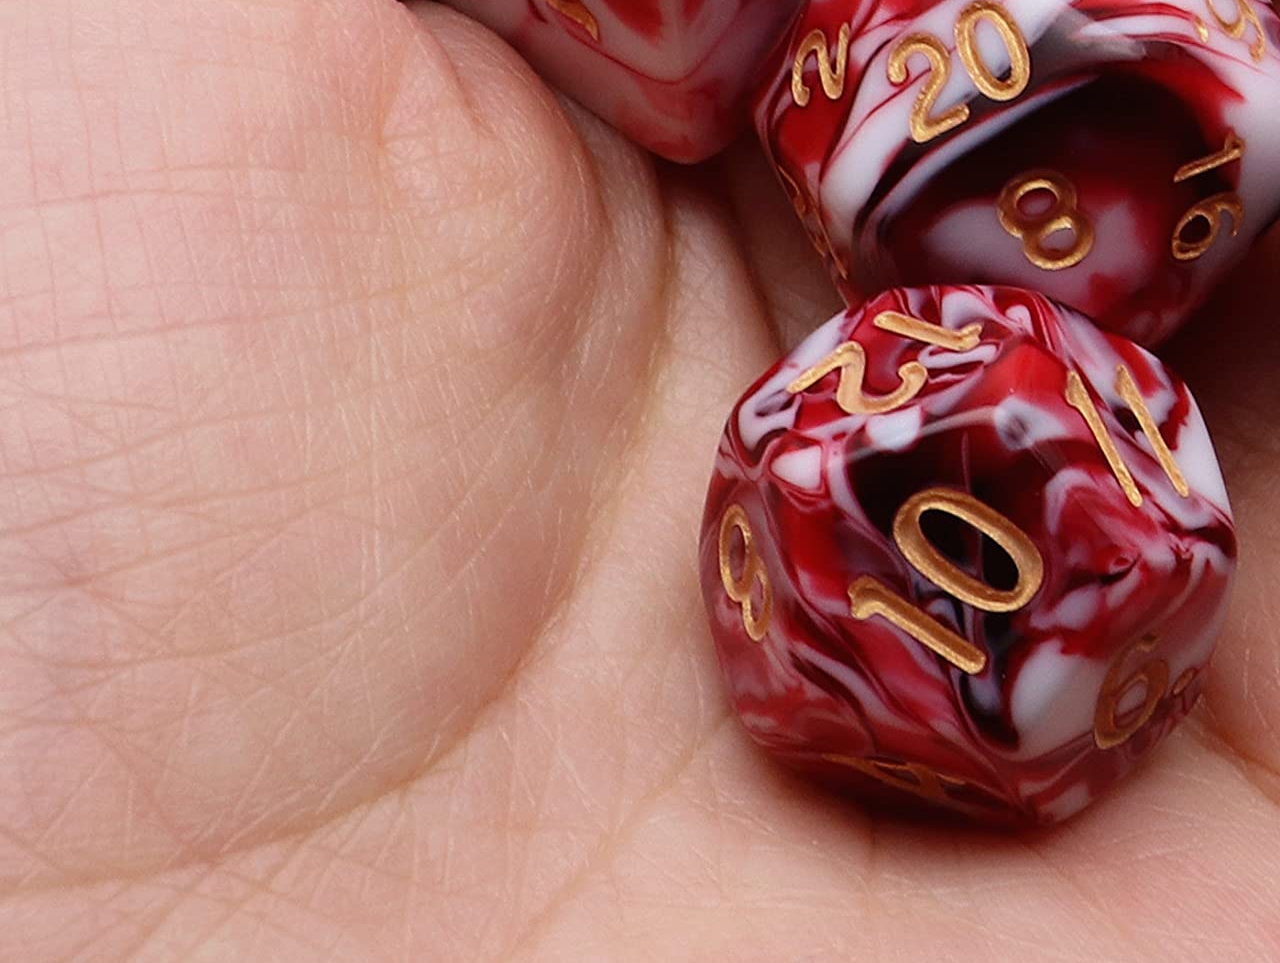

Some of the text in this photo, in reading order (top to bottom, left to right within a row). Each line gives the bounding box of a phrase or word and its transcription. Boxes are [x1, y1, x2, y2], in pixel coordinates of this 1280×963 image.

[791, 22, 850, 107] 2
[999, 171, 1094, 270] 8
[1170, 133, 1245, 261] 16
[786, 310, 983, 415] 12
[1065, 364, 1190, 508] 11
[848, 486, 1044, 675] 10
